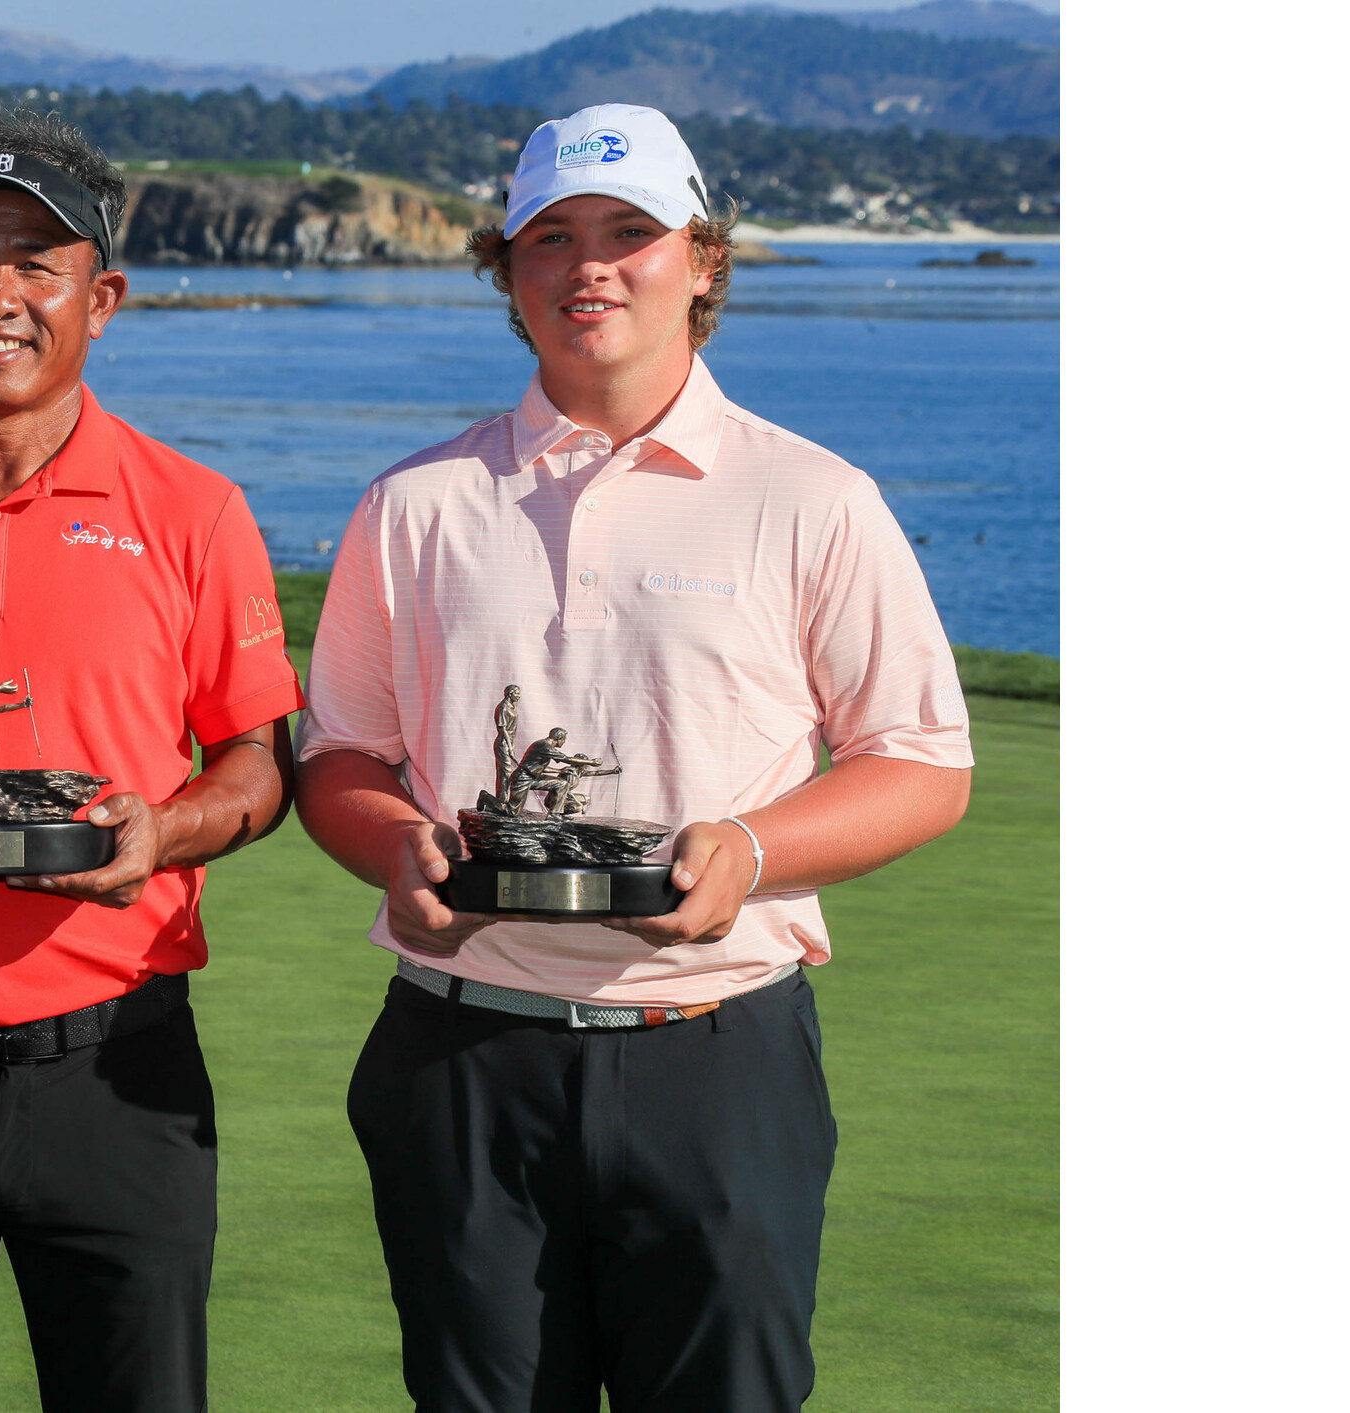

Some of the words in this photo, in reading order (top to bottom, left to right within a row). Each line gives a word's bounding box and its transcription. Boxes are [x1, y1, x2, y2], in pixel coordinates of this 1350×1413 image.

[560, 141, 602, 159] pure
[73, 530, 98, 545] Art
[100, 535, 115, 549] of
[118, 537, 145, 557] Golf
[668, 573, 702, 592] first
[705, 580, 736, 596] tee
